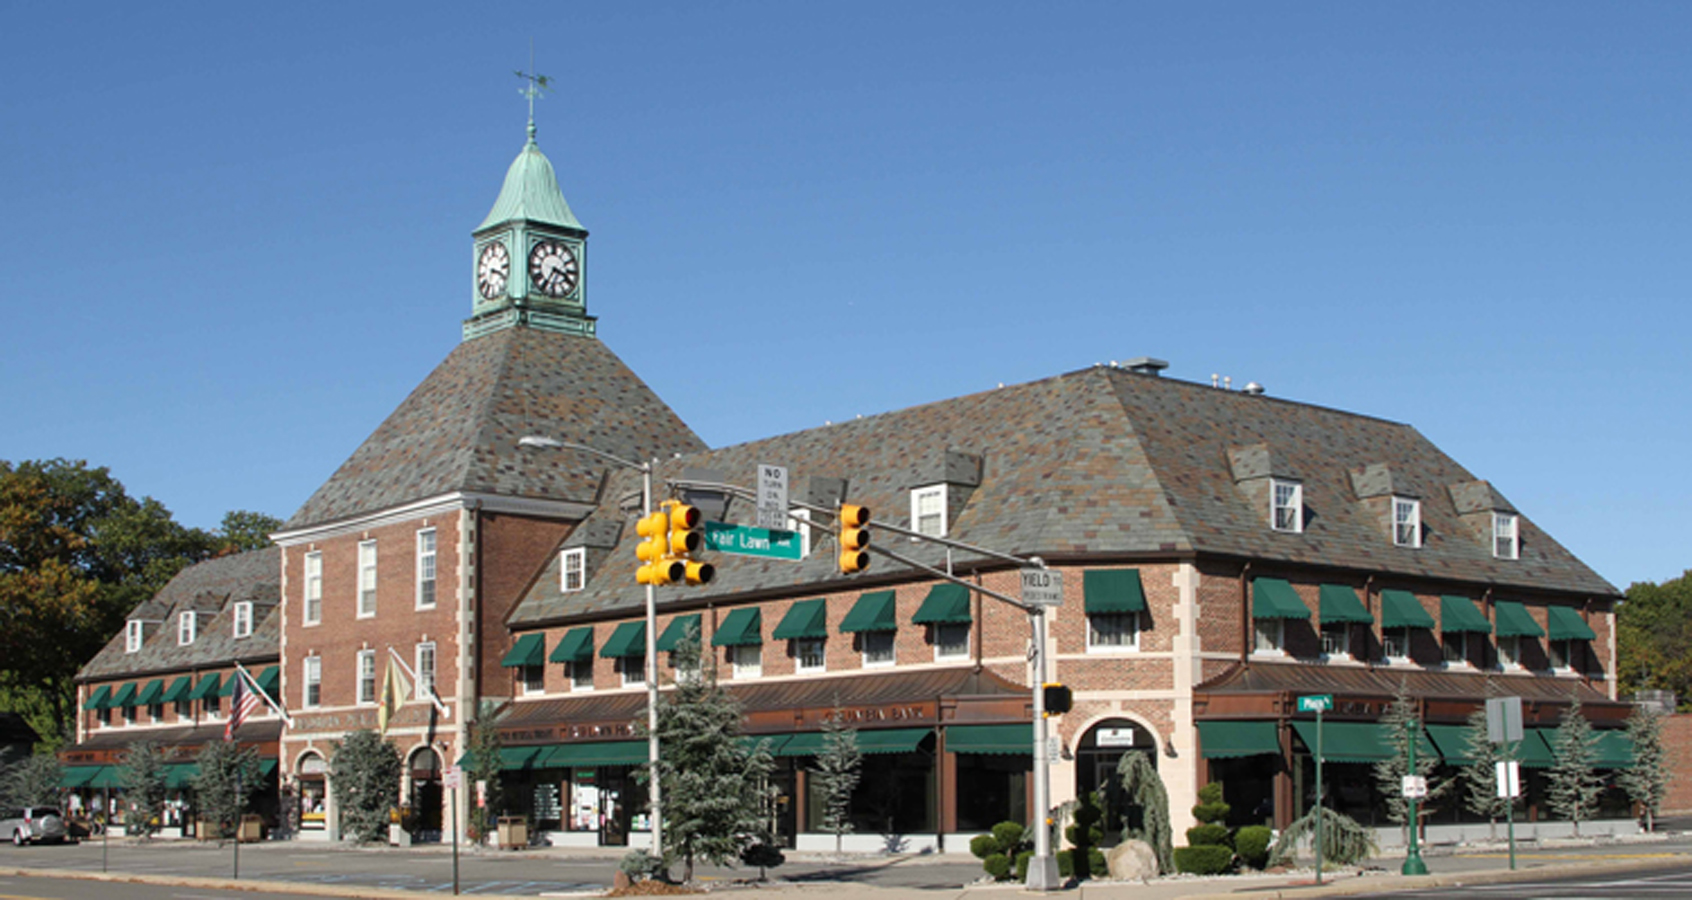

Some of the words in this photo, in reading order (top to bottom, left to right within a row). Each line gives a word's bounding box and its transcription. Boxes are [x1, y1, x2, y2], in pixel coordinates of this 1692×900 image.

[764, 468, 781, 479] NO
[763, 479, 783, 489] TURN
[766, 490, 779, 500] ON
[740, 532, 770, 551] Lawn
[1022, 572, 1050, 587] YIELD
